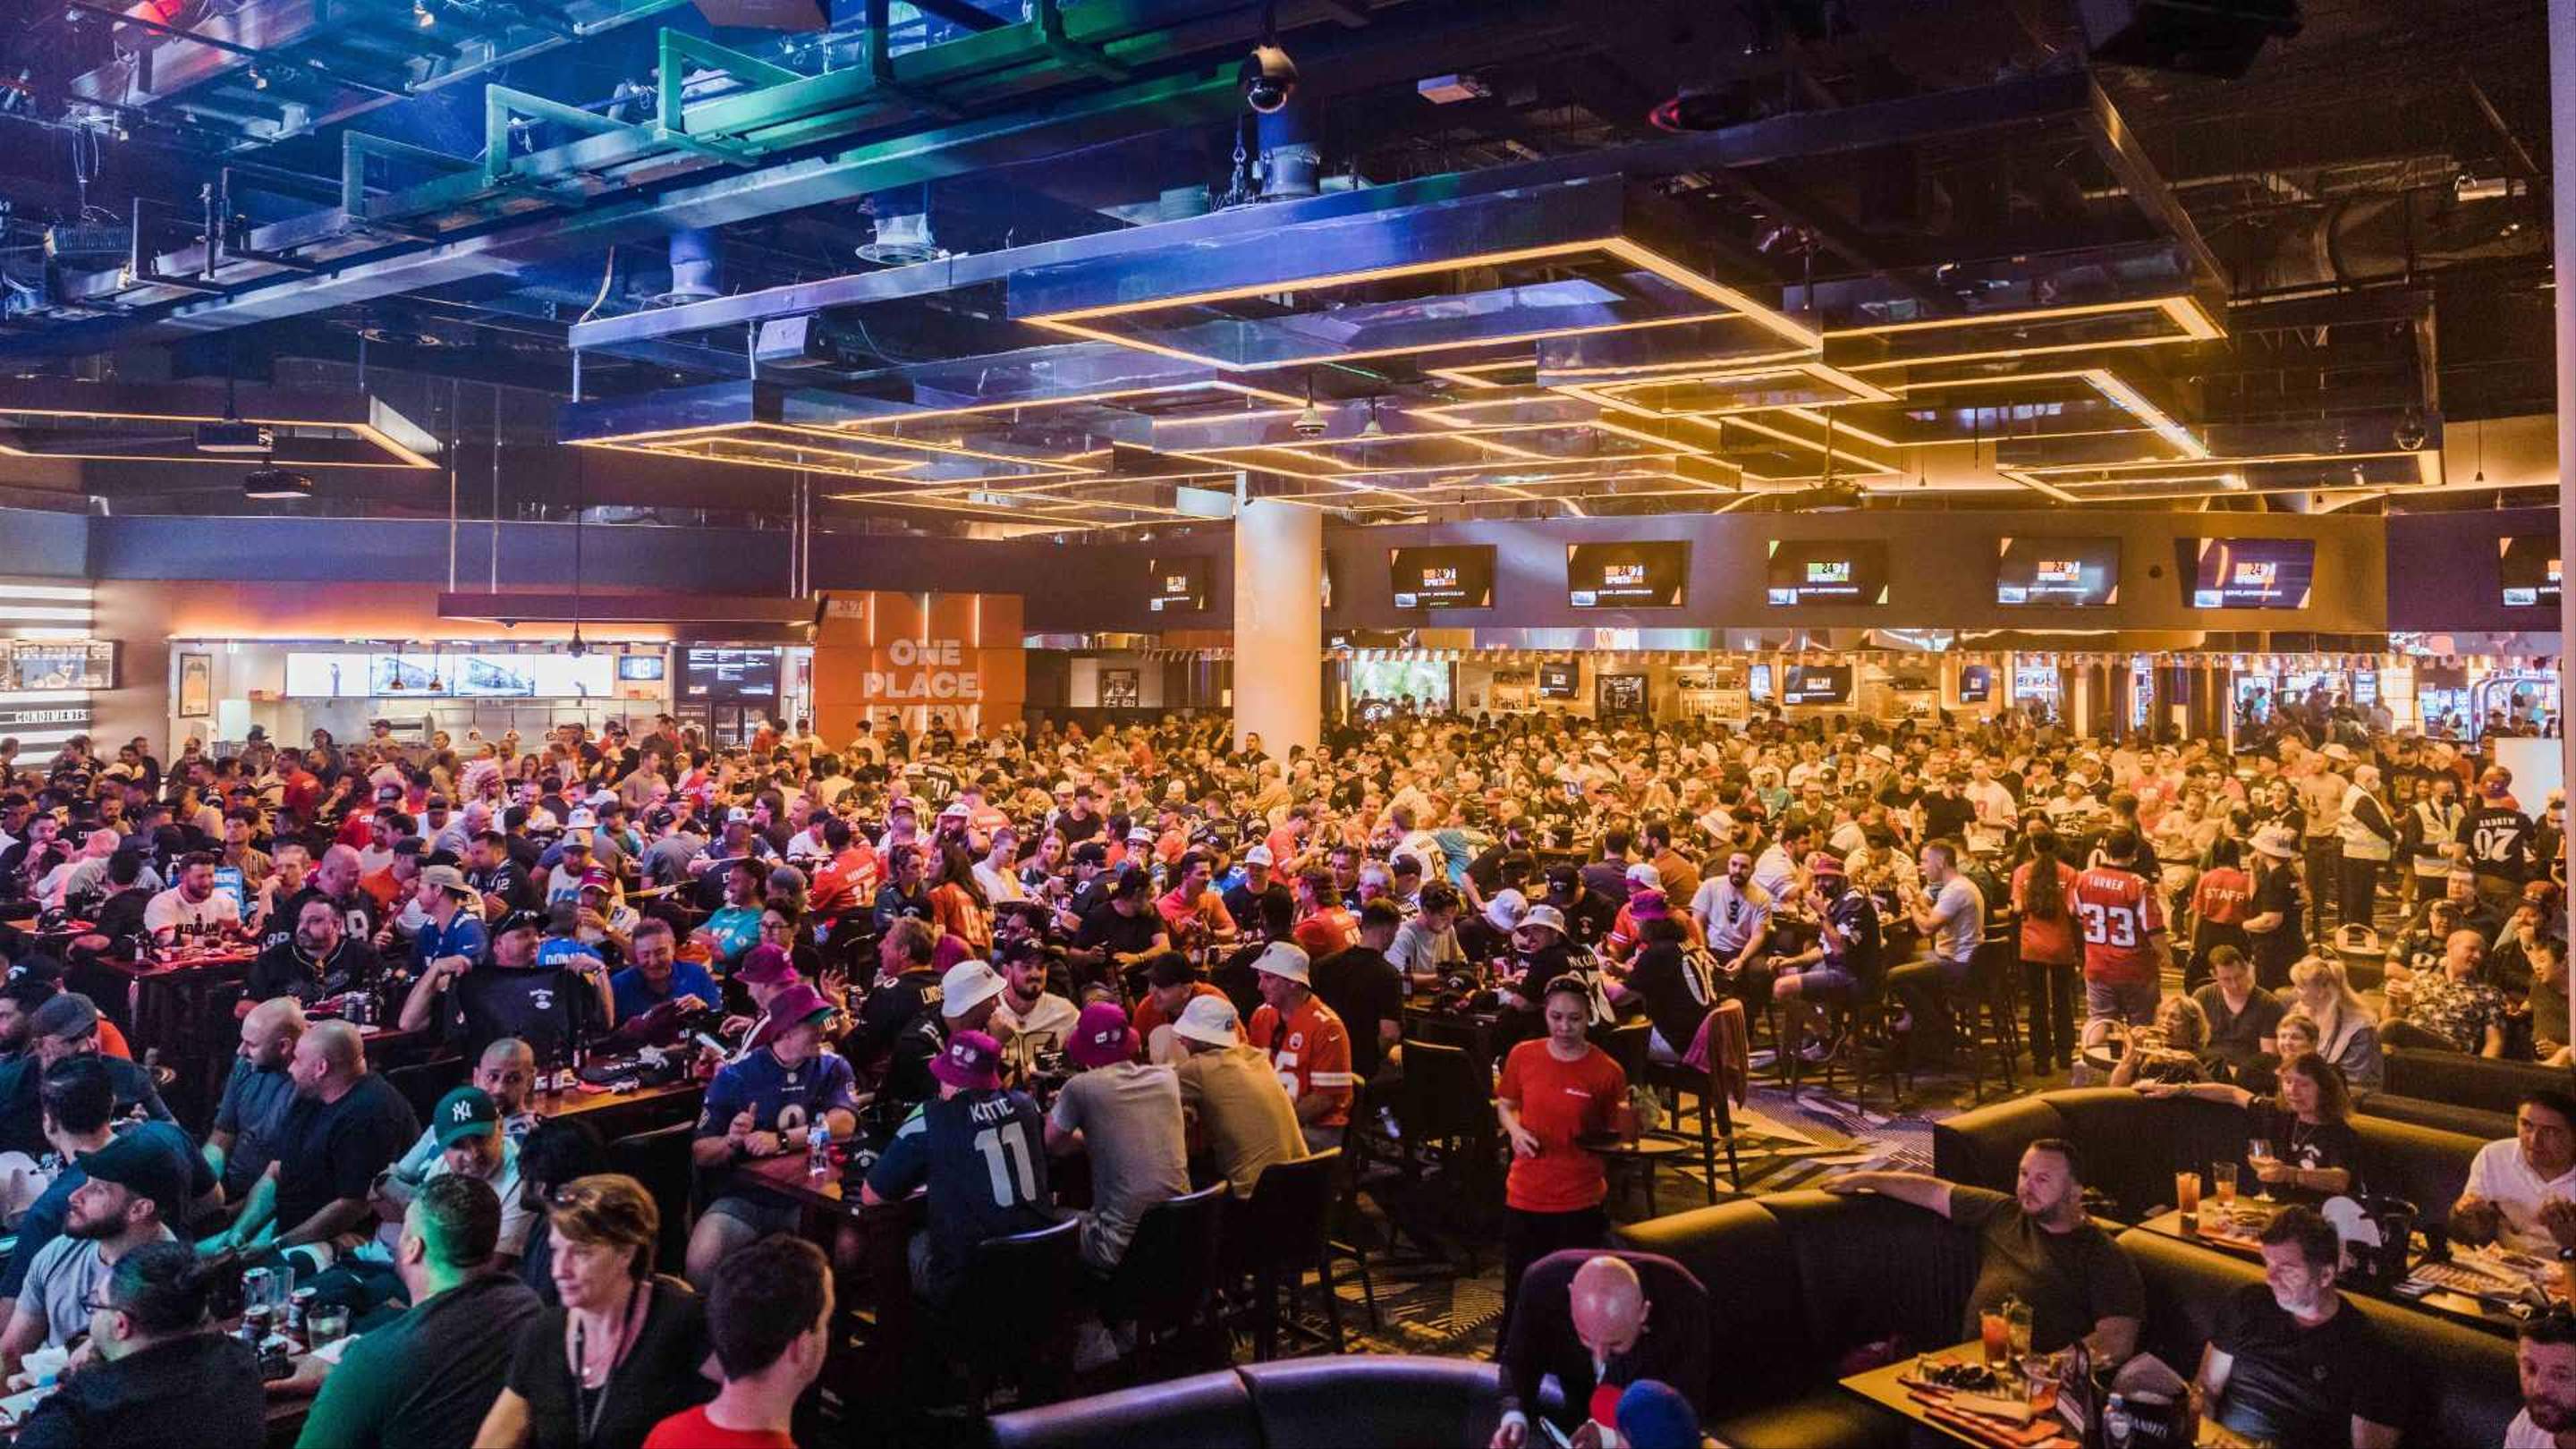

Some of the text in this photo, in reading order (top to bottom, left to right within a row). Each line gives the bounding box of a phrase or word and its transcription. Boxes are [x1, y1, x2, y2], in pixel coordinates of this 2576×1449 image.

[890, 639, 962, 665] ONE
[872, 704, 982, 732] EVERY
[2203, 886, 2246, 902] STAFF
[2082, 903, 2136, 947] 33
[974, 1121, 1038, 1208] 11
